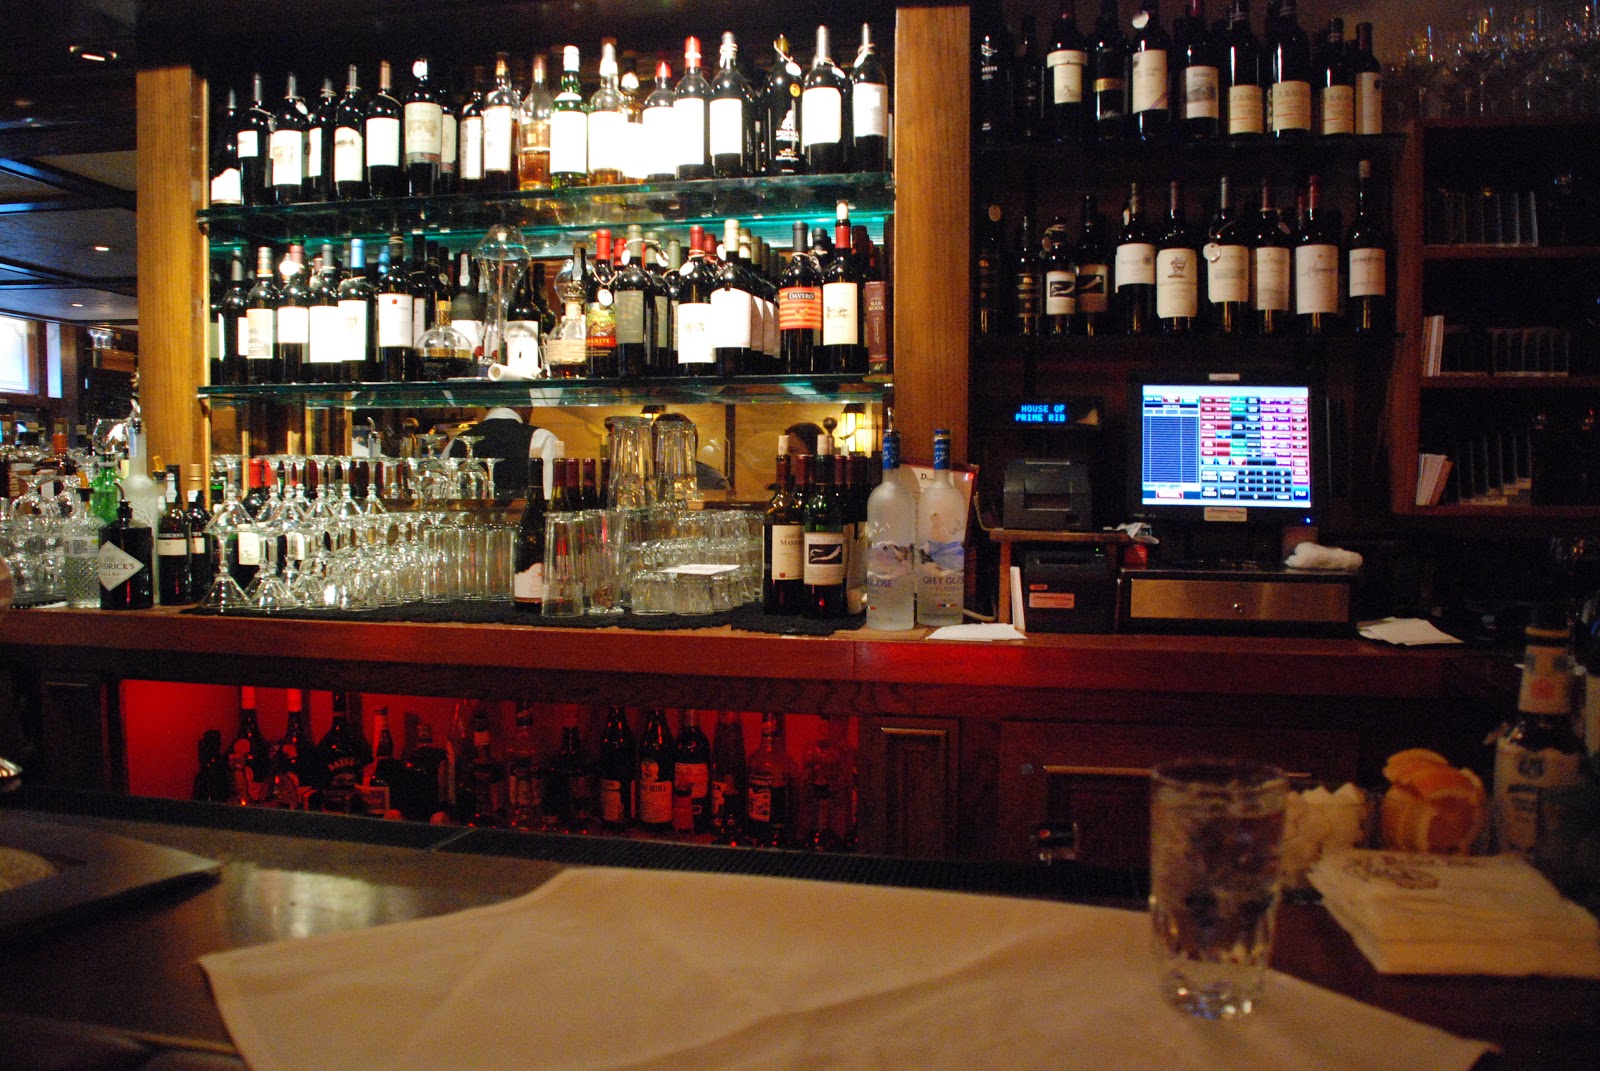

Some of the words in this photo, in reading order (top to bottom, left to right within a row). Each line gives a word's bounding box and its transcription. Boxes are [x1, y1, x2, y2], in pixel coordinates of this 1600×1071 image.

[1021, 404, 1049, 413] HOUSE
[1054, 404, 1066, 413] OF
[1015, 413, 1043, 422] PRIME
[1048, 413, 1066, 422] RIB
[922, 577, 943, 585] GREY
